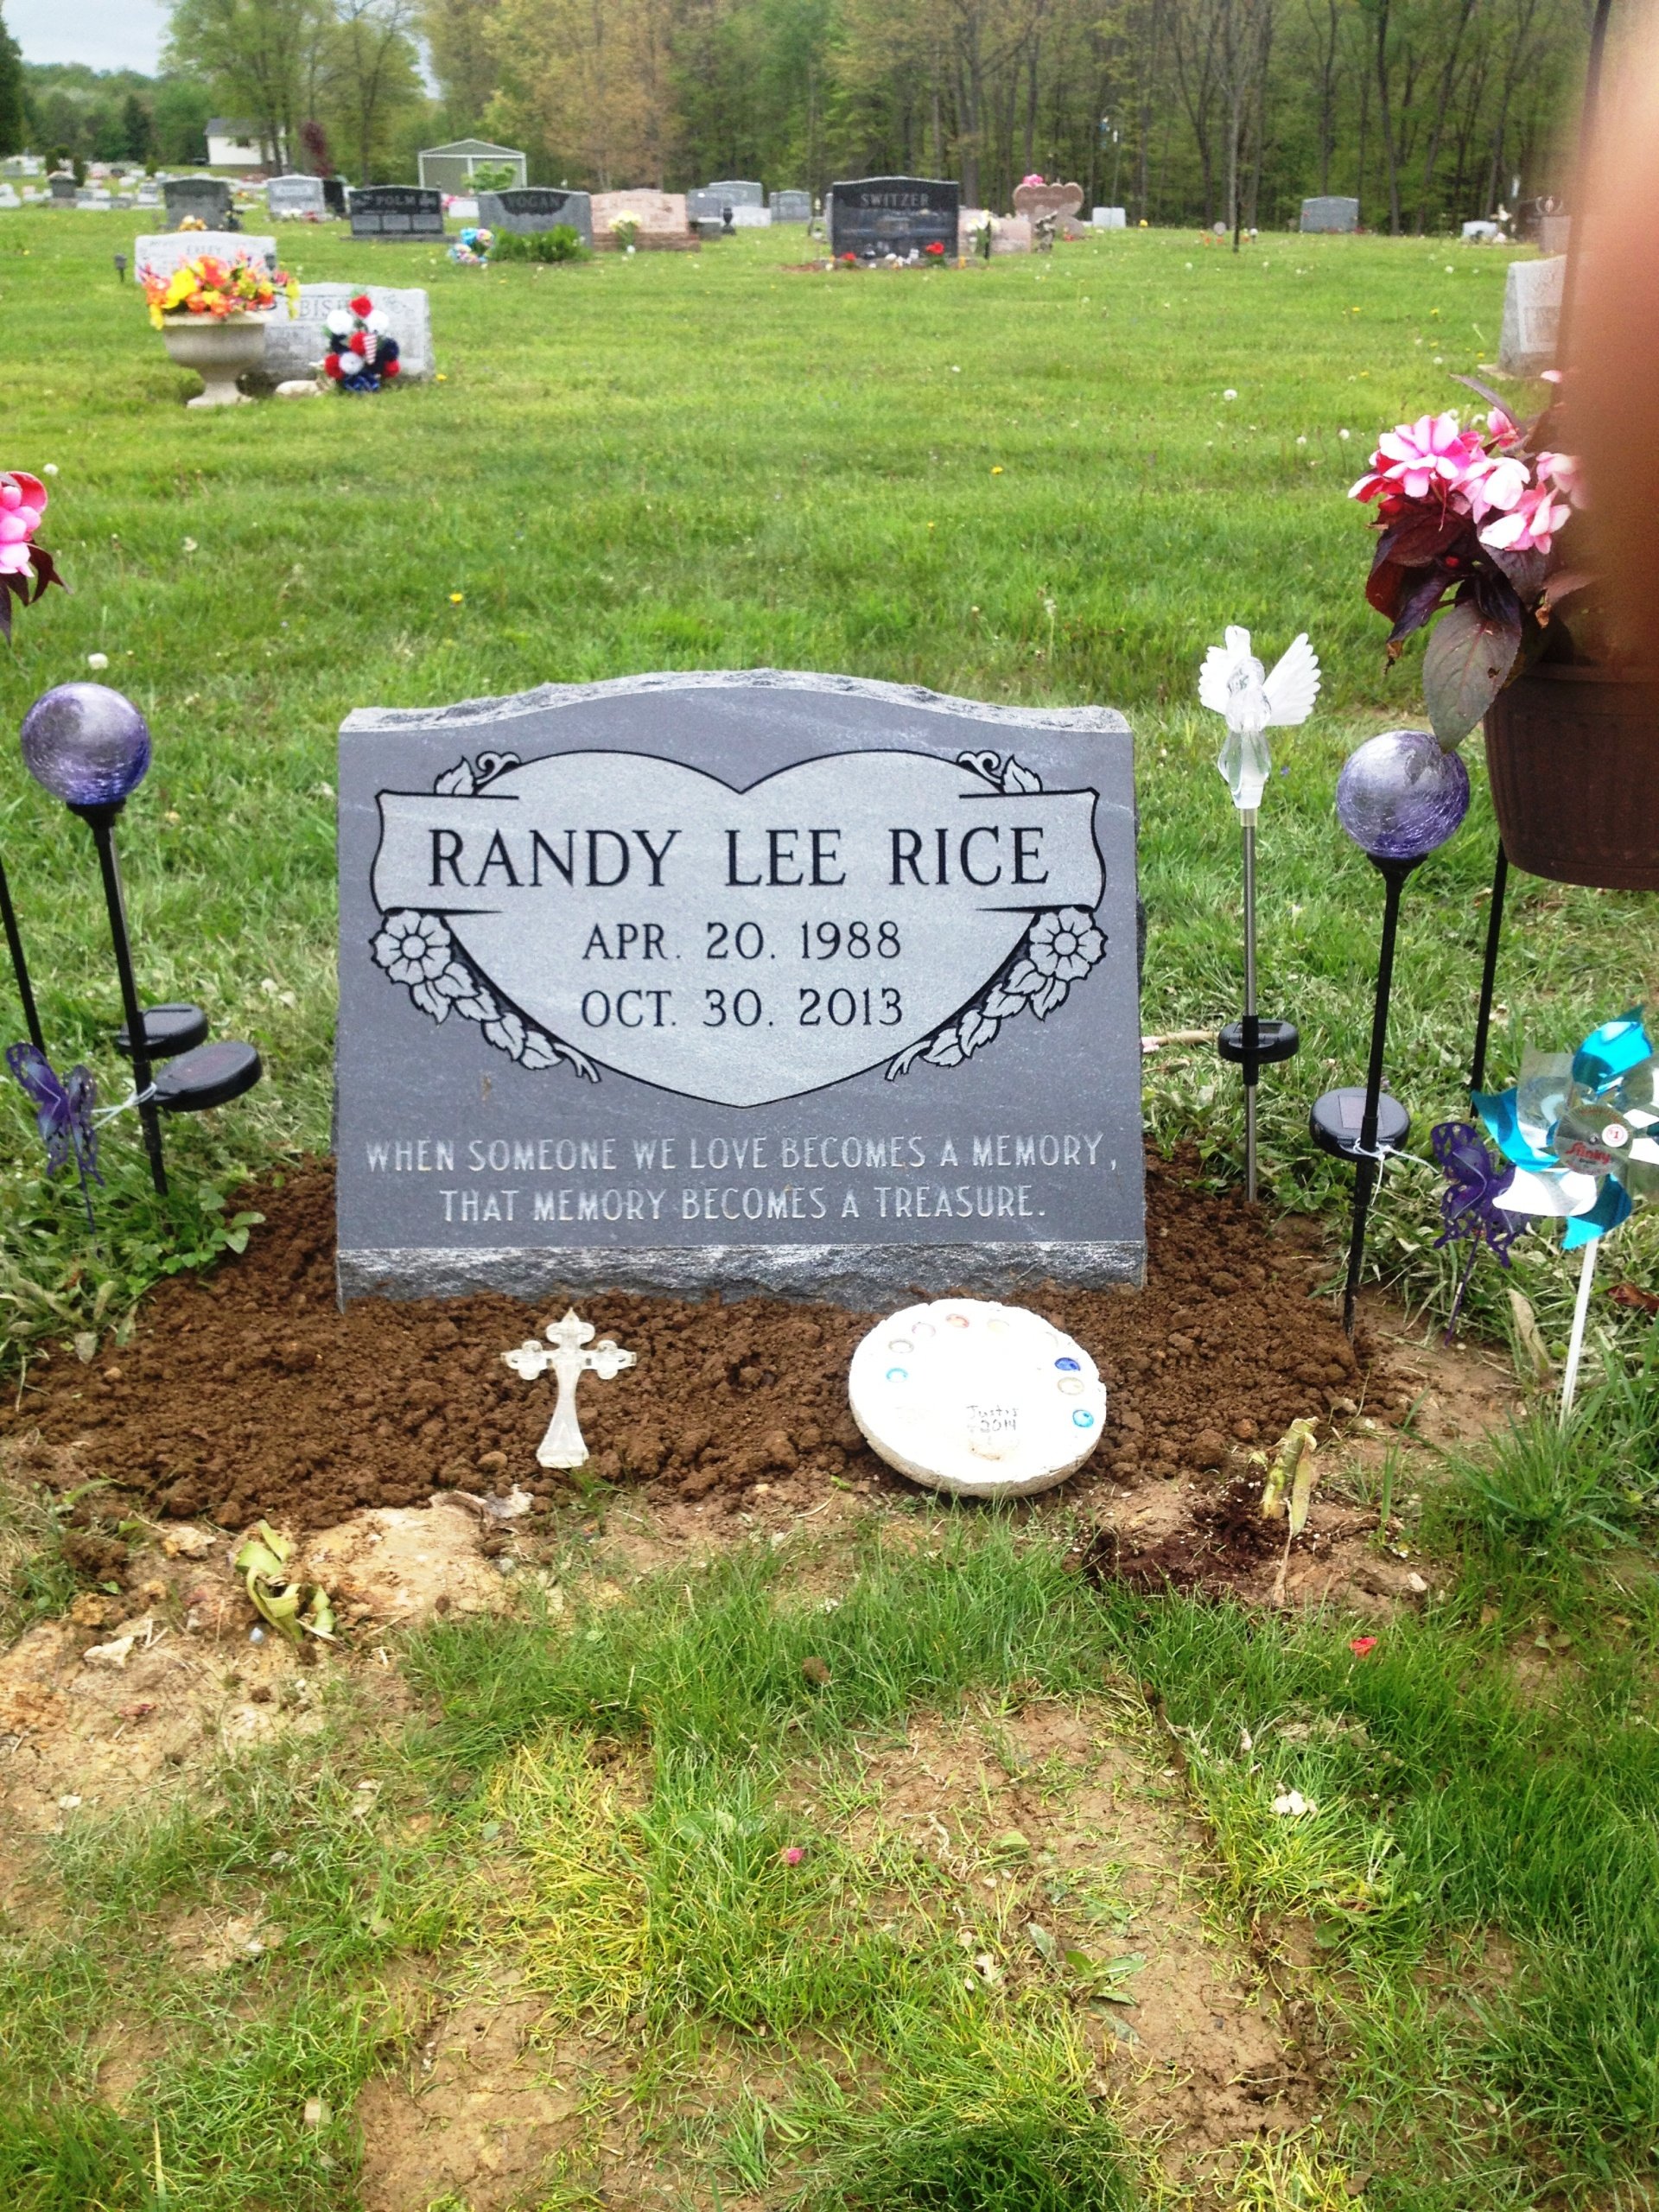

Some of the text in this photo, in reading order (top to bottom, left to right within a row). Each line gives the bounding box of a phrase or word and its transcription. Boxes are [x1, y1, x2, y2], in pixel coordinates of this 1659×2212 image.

[861, 193, 930, 207] SWITZER
[428, 825, 1050, 887] RANDY LEE RICE
[582, 920, 901, 961] APR. 20. 1988
[581, 988, 903, 1028] OCT. 30. 2013
[366, 1134, 1118, 1173] WHEN SOMEONE WE LOVE BECOMES A MEMORY,
[439, 1185, 1047, 1223] THAT MEMORY BECOMES A TREASURE.
